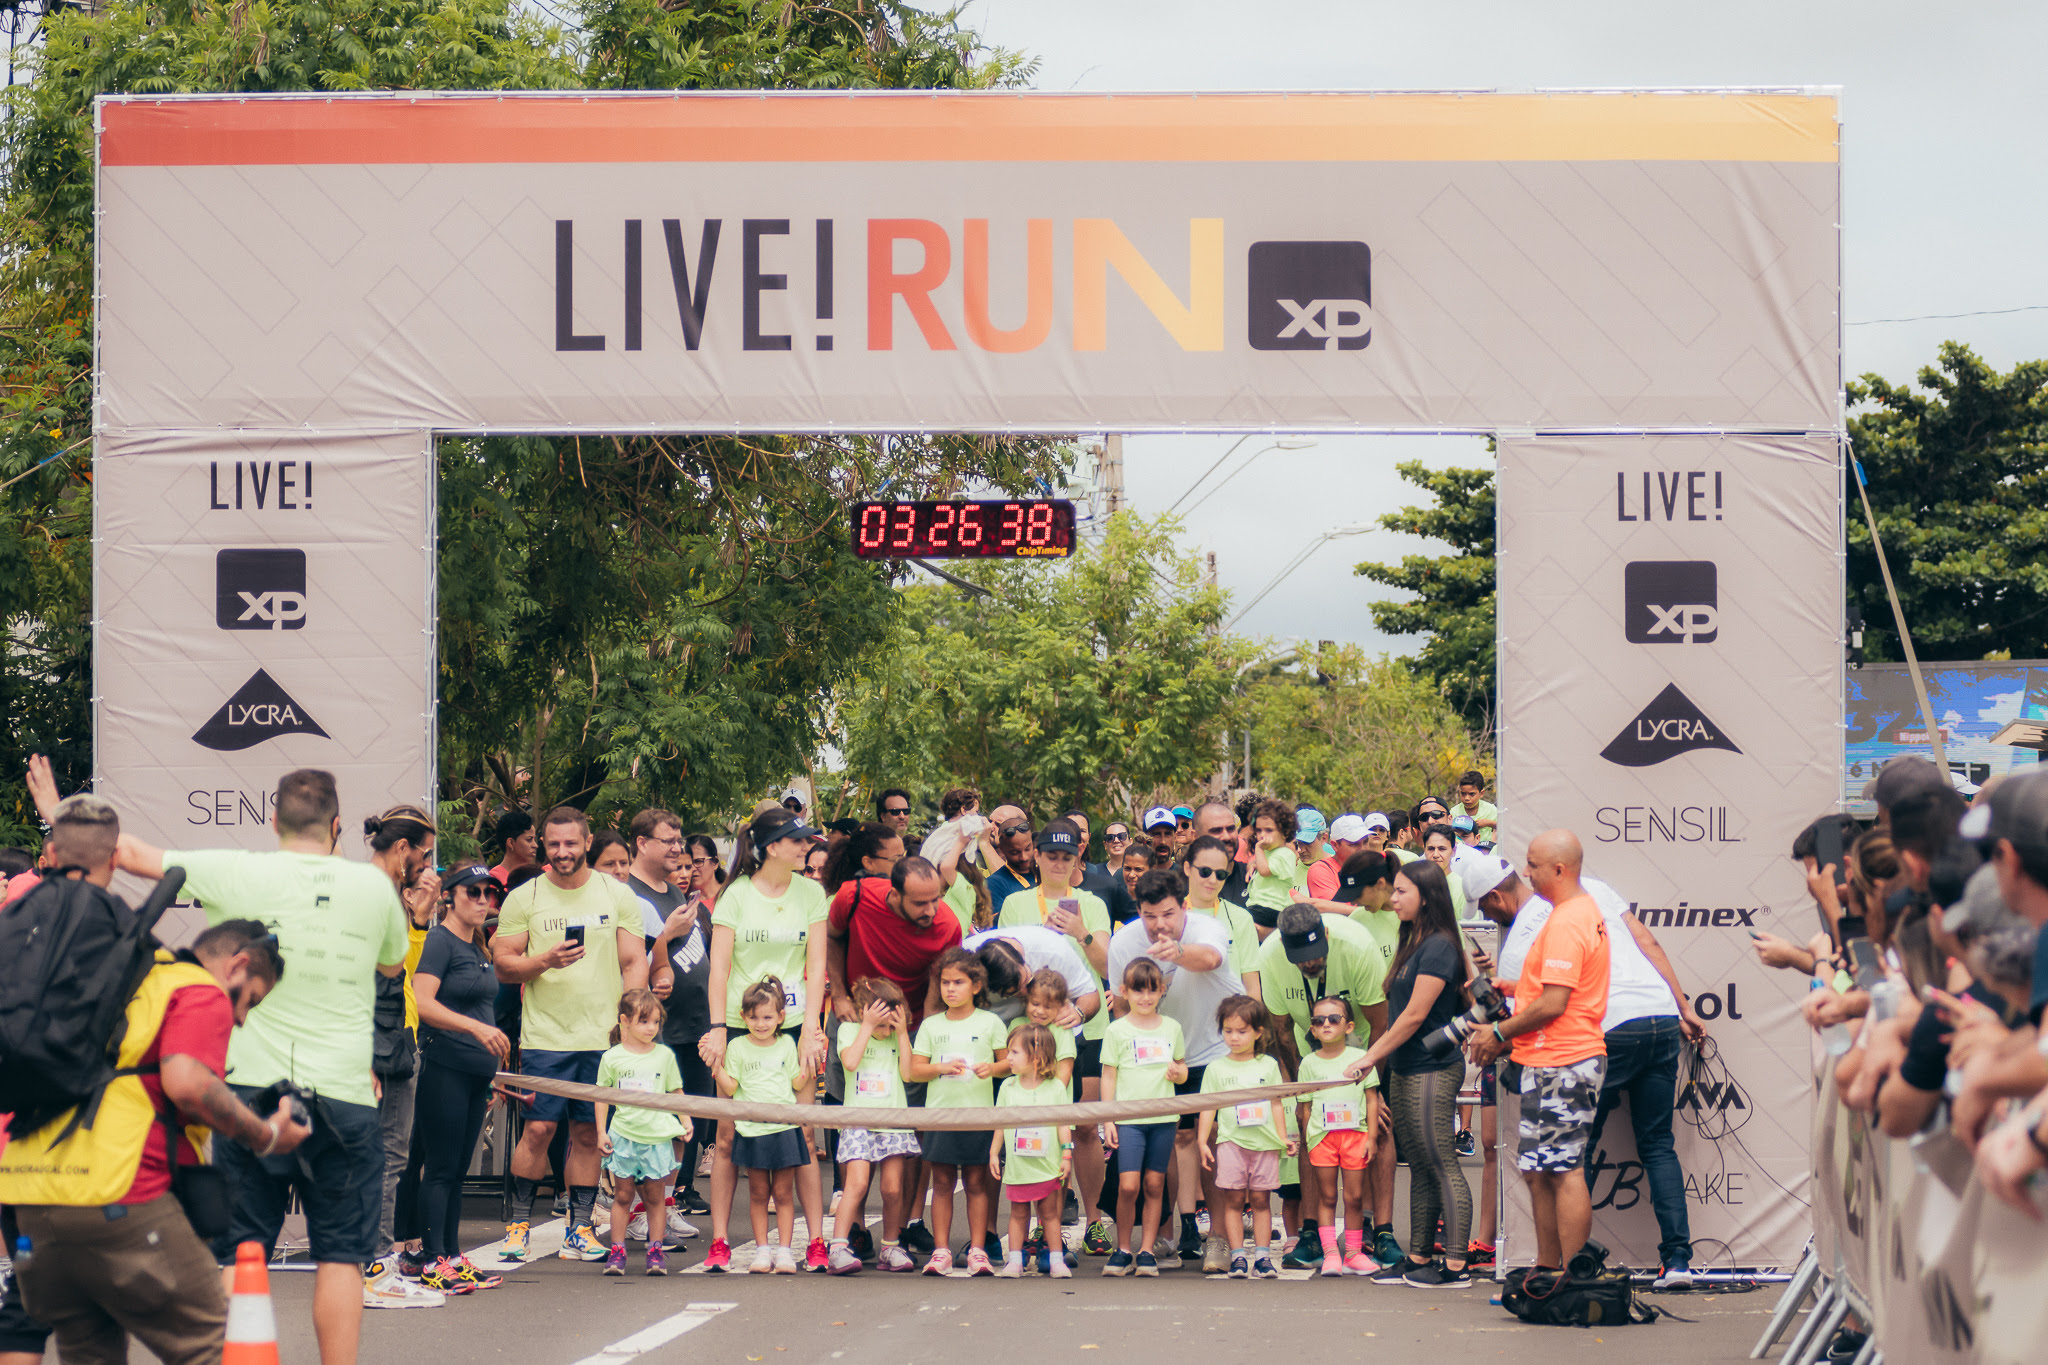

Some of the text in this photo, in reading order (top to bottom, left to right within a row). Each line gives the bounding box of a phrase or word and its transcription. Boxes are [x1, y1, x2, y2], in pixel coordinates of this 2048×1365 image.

[555, 217, 1225, 352] LIVE! RUN
[1275, 299, 1372, 351] XP
[210, 460, 312, 510] LIVE!
[1617, 471, 1723, 522] LIVE!
[859, 503, 1053, 548] 03 26 38
[1016, 545, 1068, 558] ChipTiming
[236, 591, 306, 631] XP
[1646, 604, 1719, 644] XP
[228, 704, 302, 726] LYCRA
[1637, 719, 1713, 741] LYCRA
[1052, 833, 1071, 843] LIVE!
[1595, 806, 1742, 843] SENSIL
[745, 929, 770, 943] LIVE!
[1333, 1111, 1345, 1123] 13
[1025, 1138, 1033, 1150] 5
